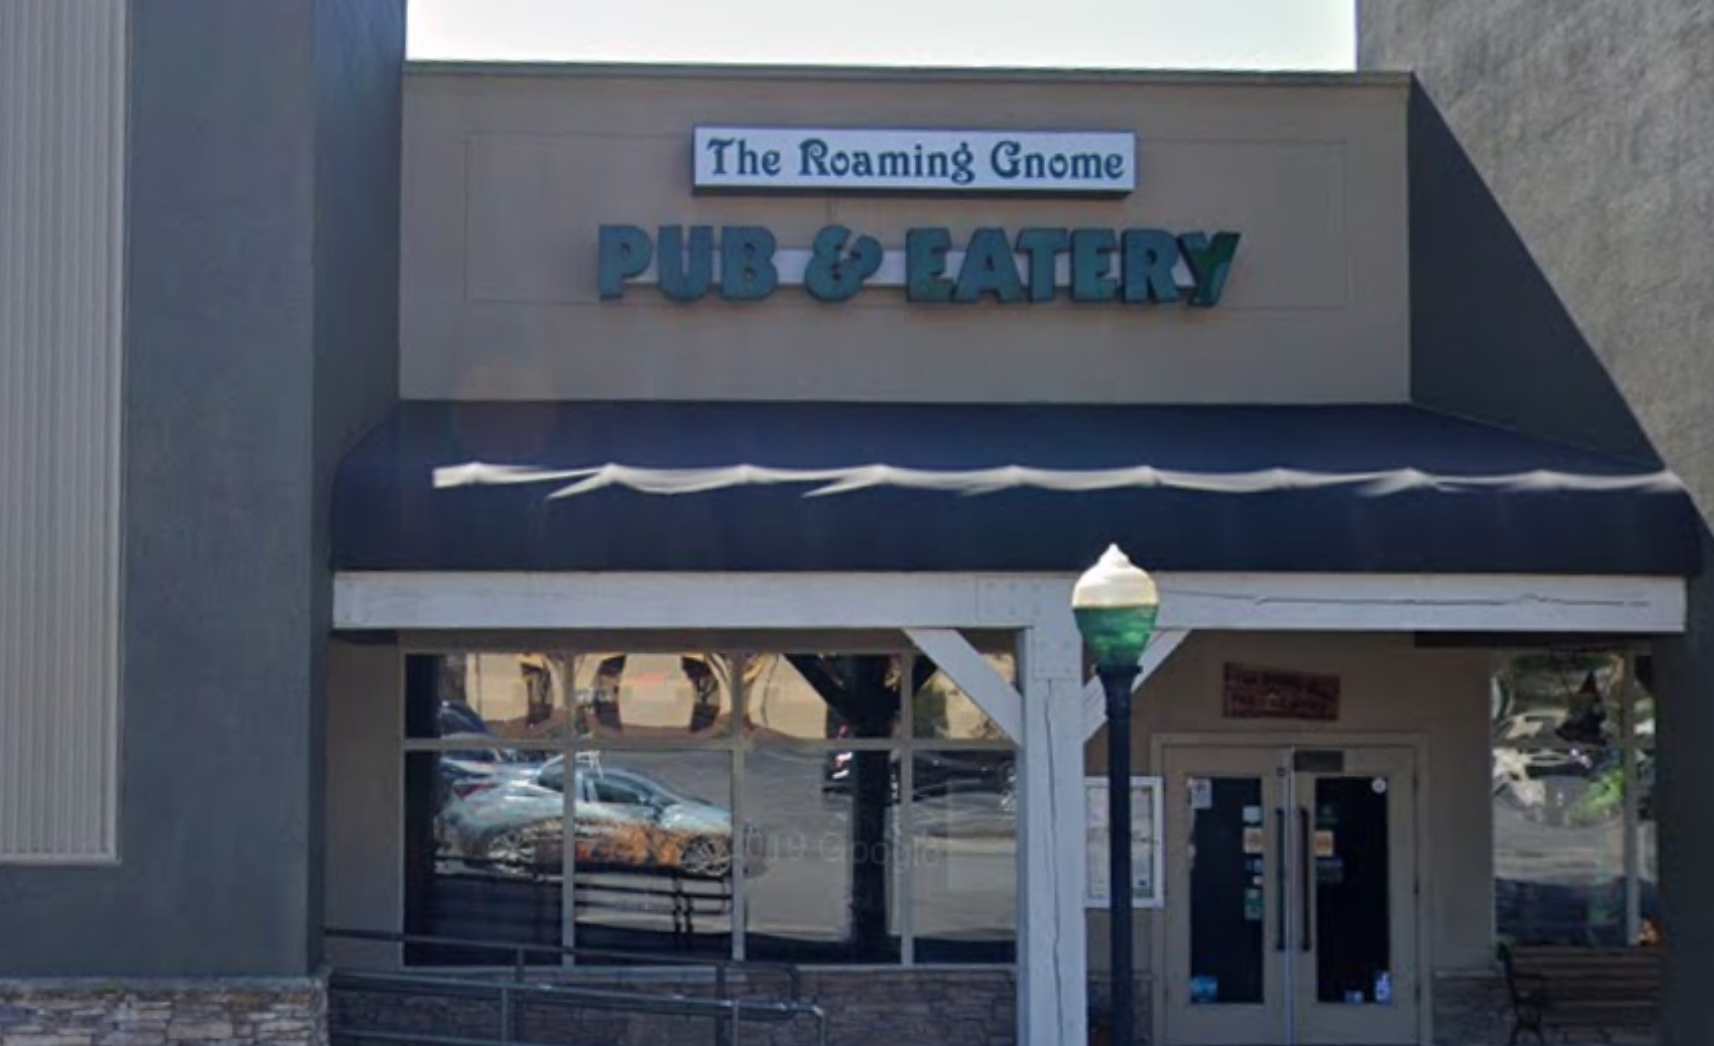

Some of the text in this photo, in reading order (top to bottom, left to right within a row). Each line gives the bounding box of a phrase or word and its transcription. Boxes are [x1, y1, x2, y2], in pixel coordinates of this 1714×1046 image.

[706, 138, 1125, 185] The Roaming Gnome
[597, 224, 1242, 308] PUB & EATERY
